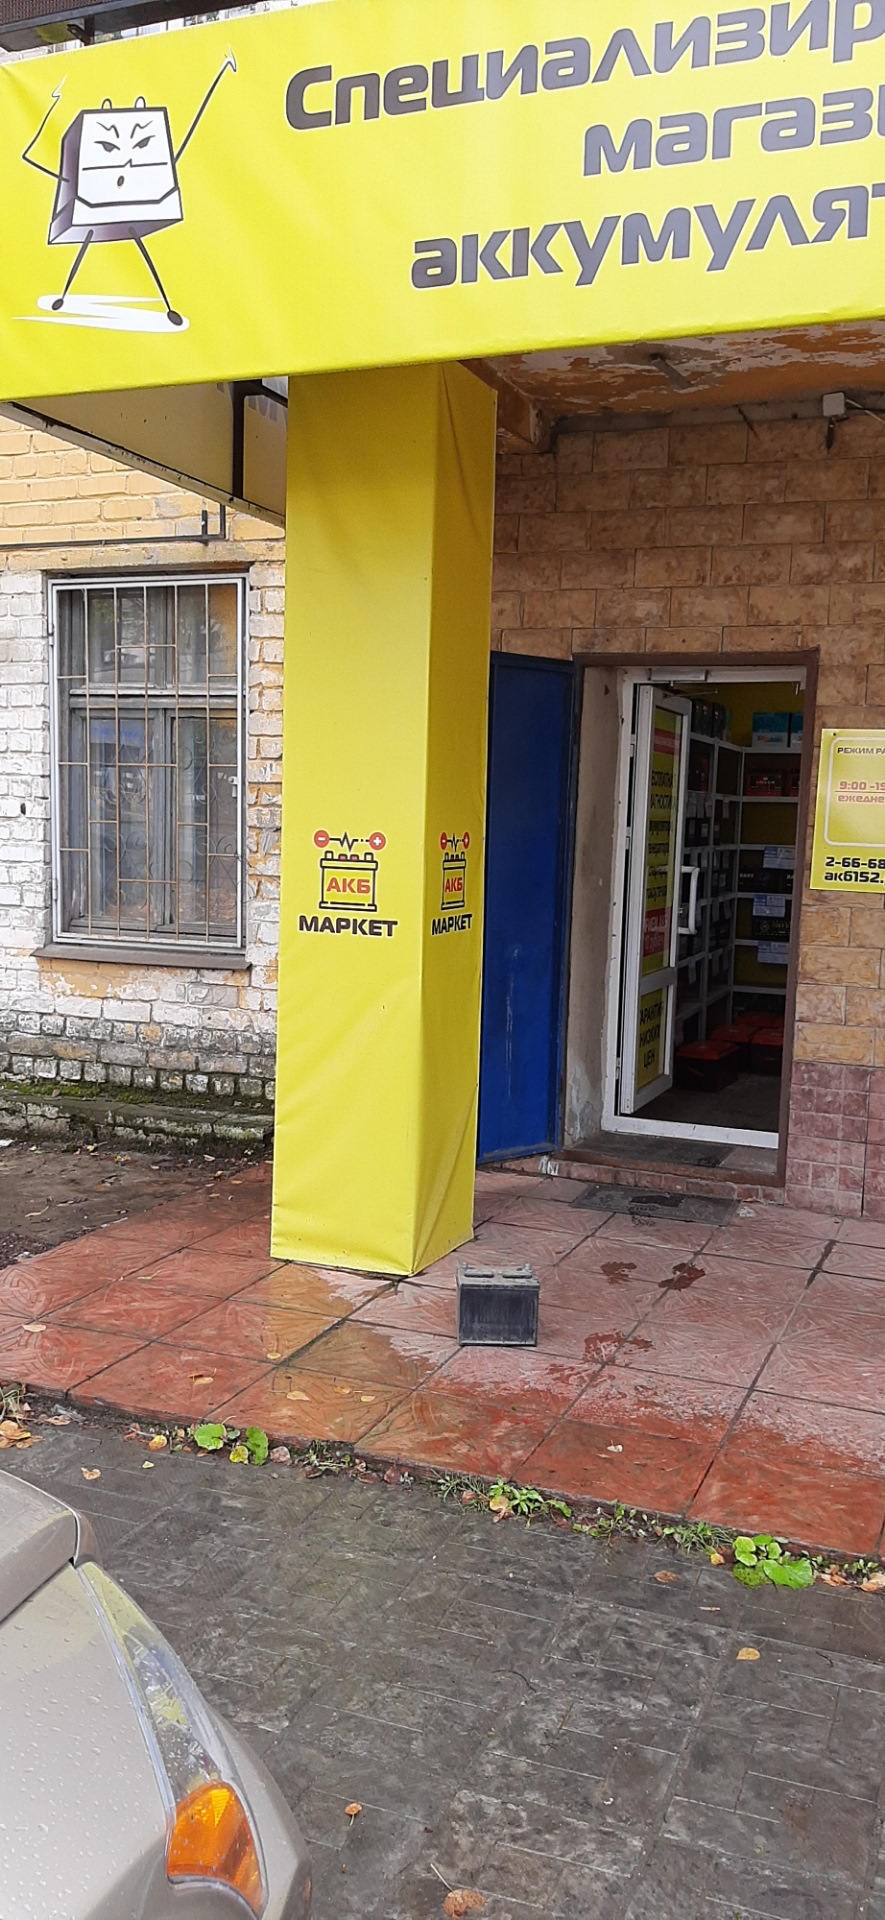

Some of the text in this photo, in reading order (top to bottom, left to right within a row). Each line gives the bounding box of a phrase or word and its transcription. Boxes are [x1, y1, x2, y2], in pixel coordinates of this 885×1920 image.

[285, 0, 885, 130] Специализир
[583, 84, 885, 176] магаз
[837, 747, 874, 755] РЕЖИМ
[839, 781, 867, 791] 9:00
[837, 794, 885, 803] ежедне
[825, 856, 885, 870] 2-66-68
[326, 877, 371, 895] АКБ
[444, 876, 463, 894] АКБ
[298, 915, 398, 937] МАРКЕТ
[431, 913, 473, 936] МАРКЕТ
